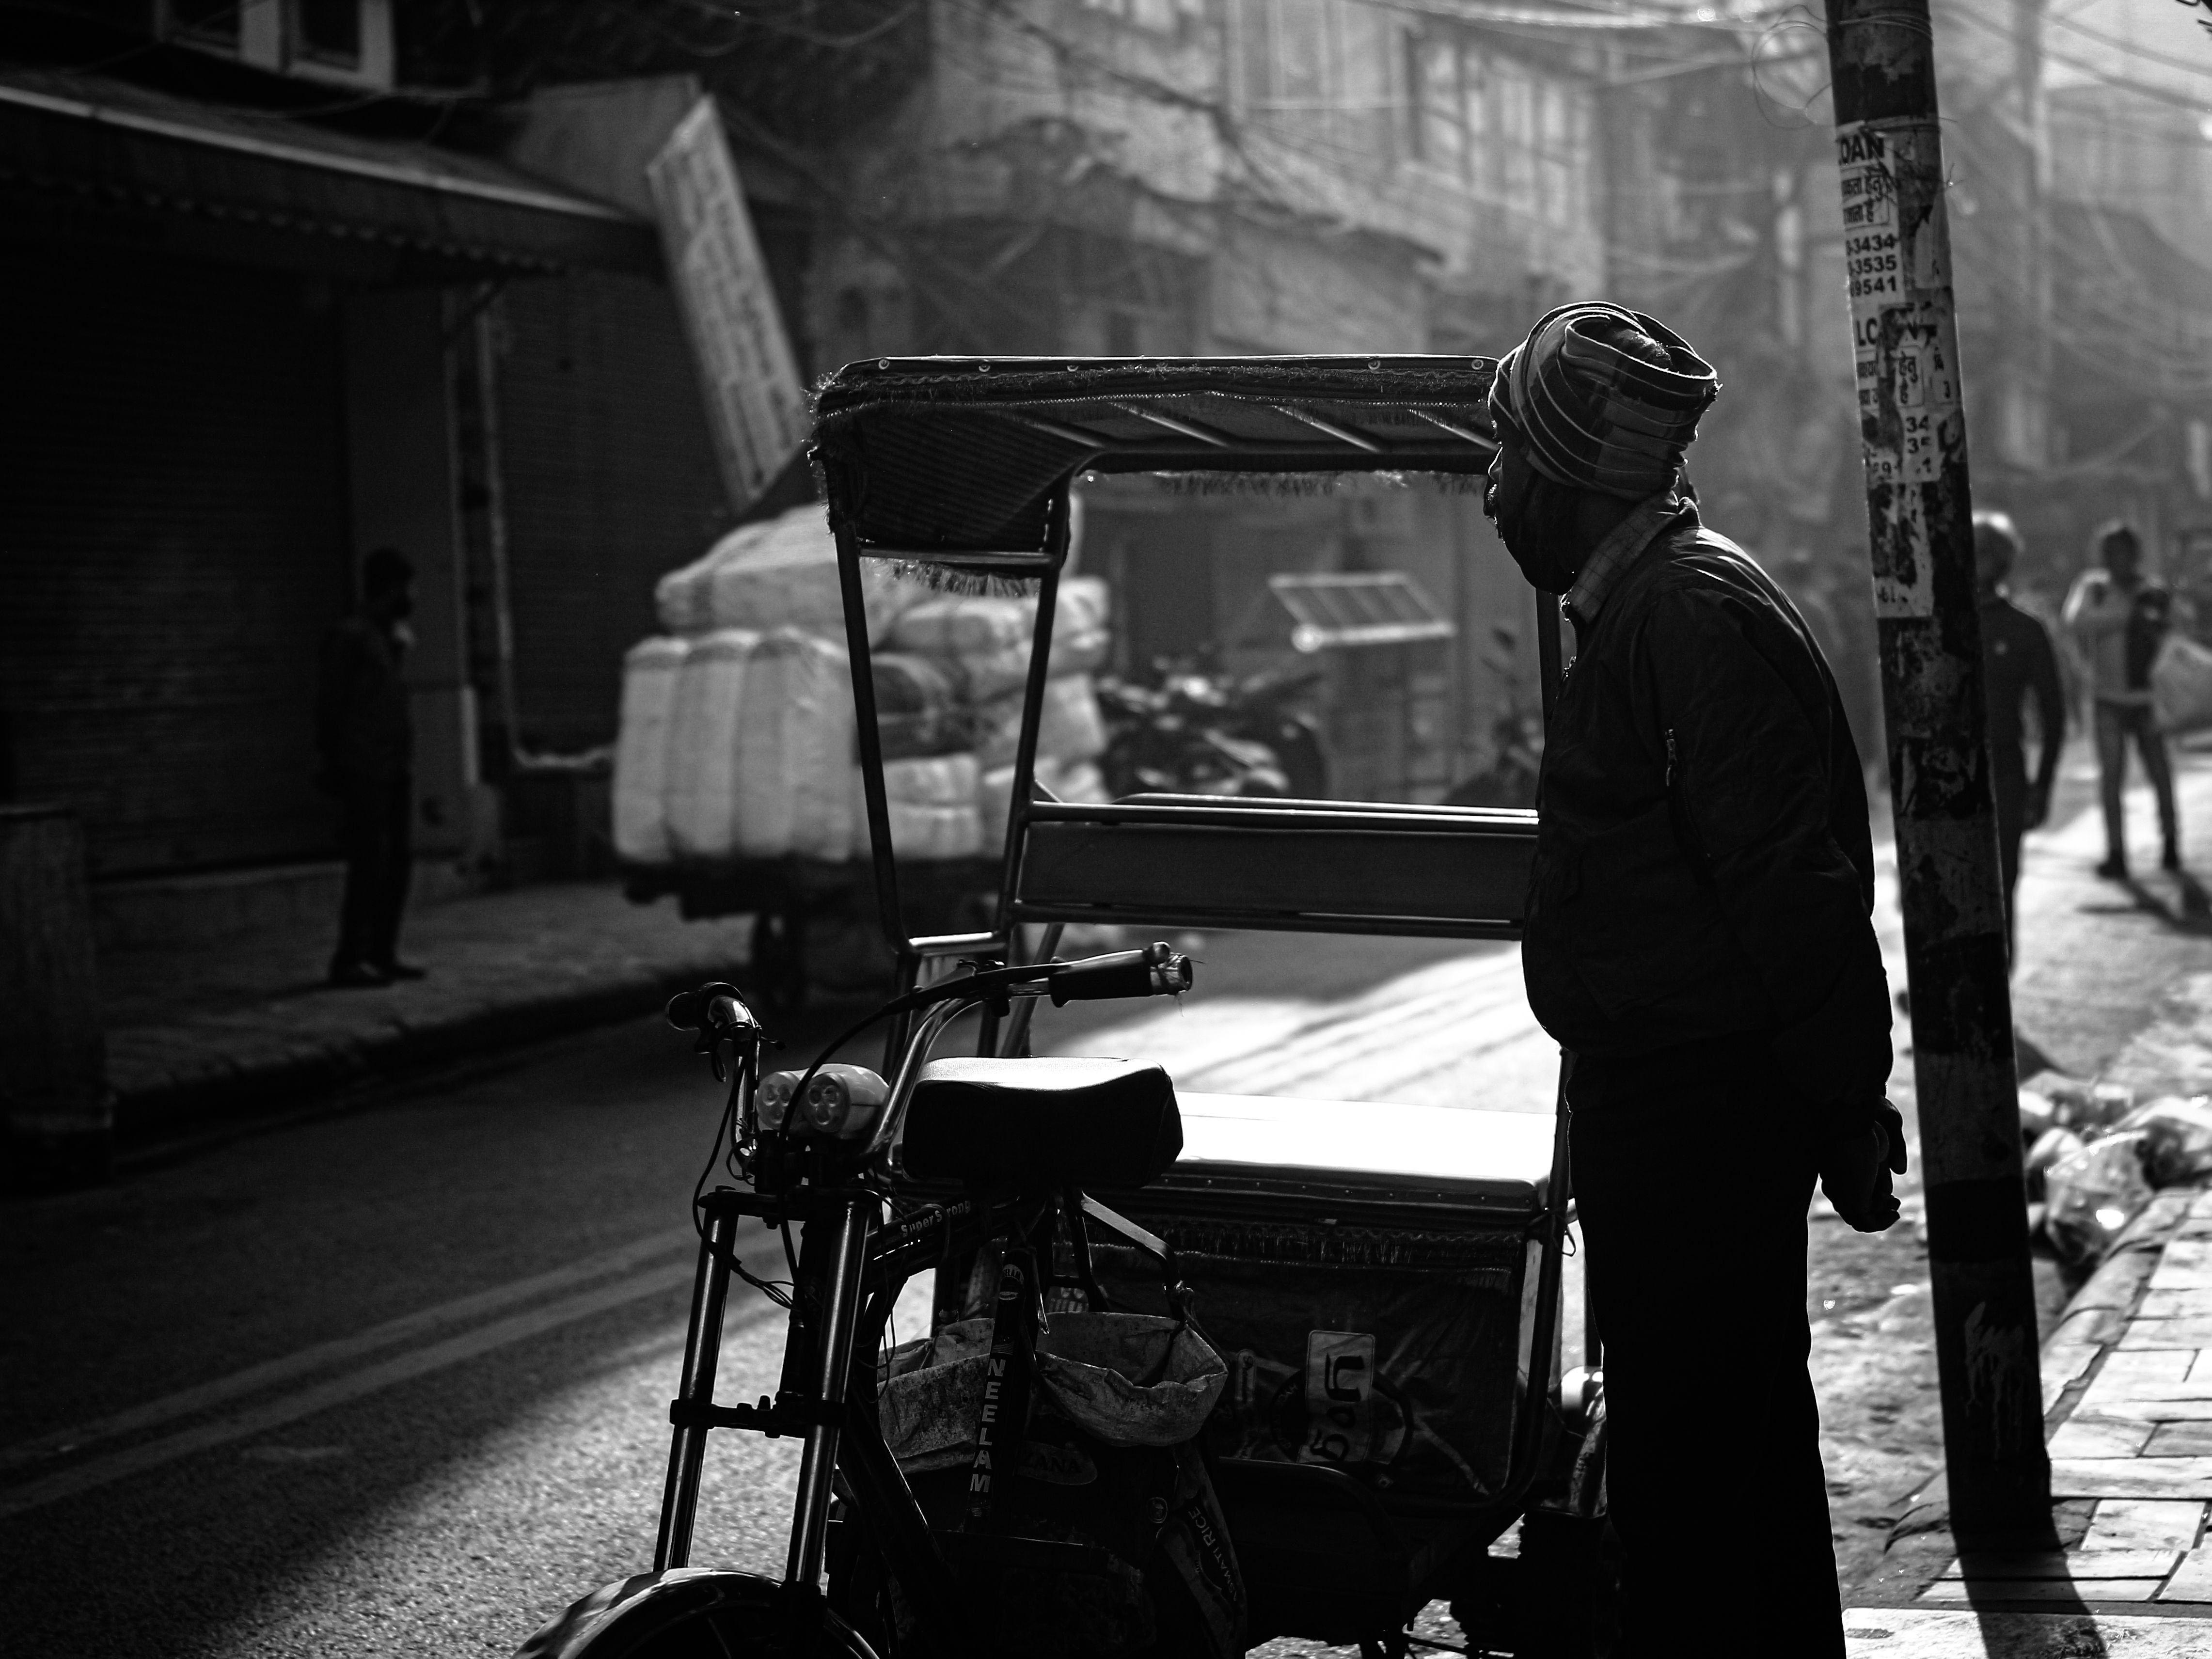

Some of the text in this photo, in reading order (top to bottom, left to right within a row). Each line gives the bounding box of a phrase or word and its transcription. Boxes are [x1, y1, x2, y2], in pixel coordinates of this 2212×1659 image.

[1839, 134, 1885, 165] OAN
[970, 1358, 1006, 1493] NEELAM
[1188, 1506, 1216, 1547] RICE
